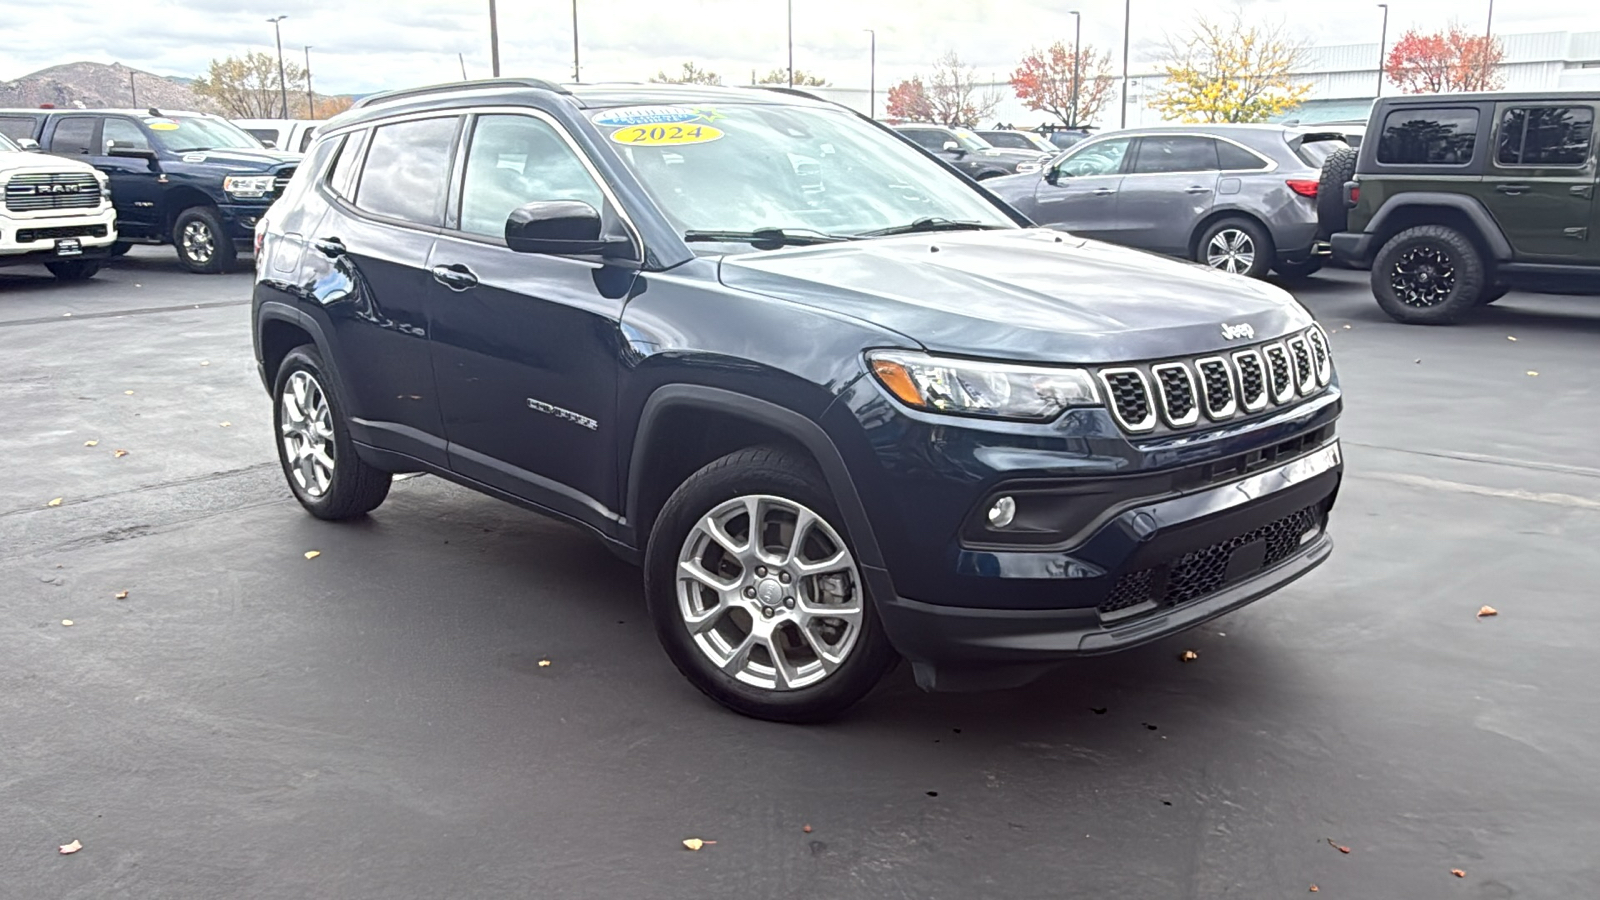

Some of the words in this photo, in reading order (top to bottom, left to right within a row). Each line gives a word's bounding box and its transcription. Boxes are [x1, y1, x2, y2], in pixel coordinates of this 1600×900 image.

[632, 126, 702, 142] 2024
[38, 185, 78, 193] RAM
[1221, 323, 1254, 340] Jeep
